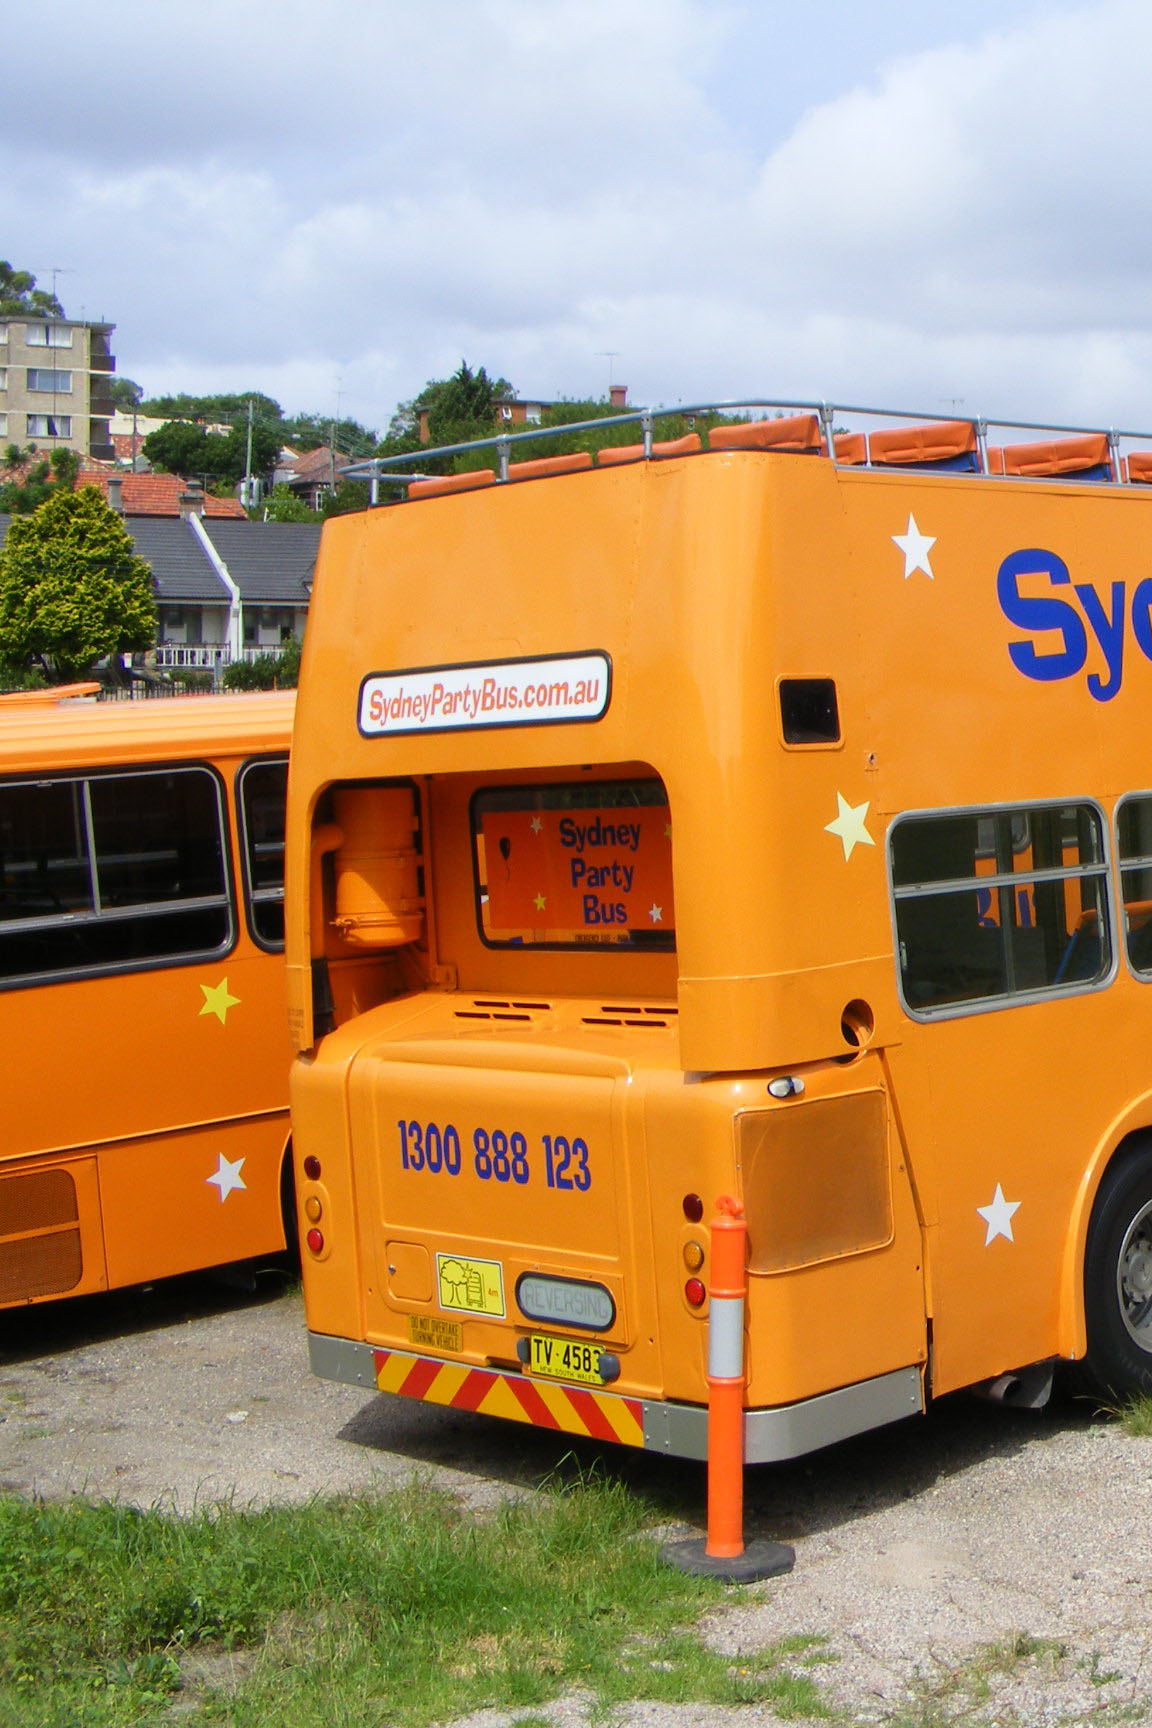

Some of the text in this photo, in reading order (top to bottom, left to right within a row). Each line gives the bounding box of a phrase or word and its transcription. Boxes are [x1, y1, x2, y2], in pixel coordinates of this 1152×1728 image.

[369, 678, 600, 726] SydneyPartyBus.com.au
[559, 816, 641, 853] Sydney
[570, 858, 634, 893] Party
[583, 894, 628, 925] Bus
[398, 1120, 591, 1191] 1300 888 123
[523, 1283, 609, 1319] REVERSING
[555, 1369, 574, 1377] SOUTH
[577, 1373, 596, 1382] WALES
